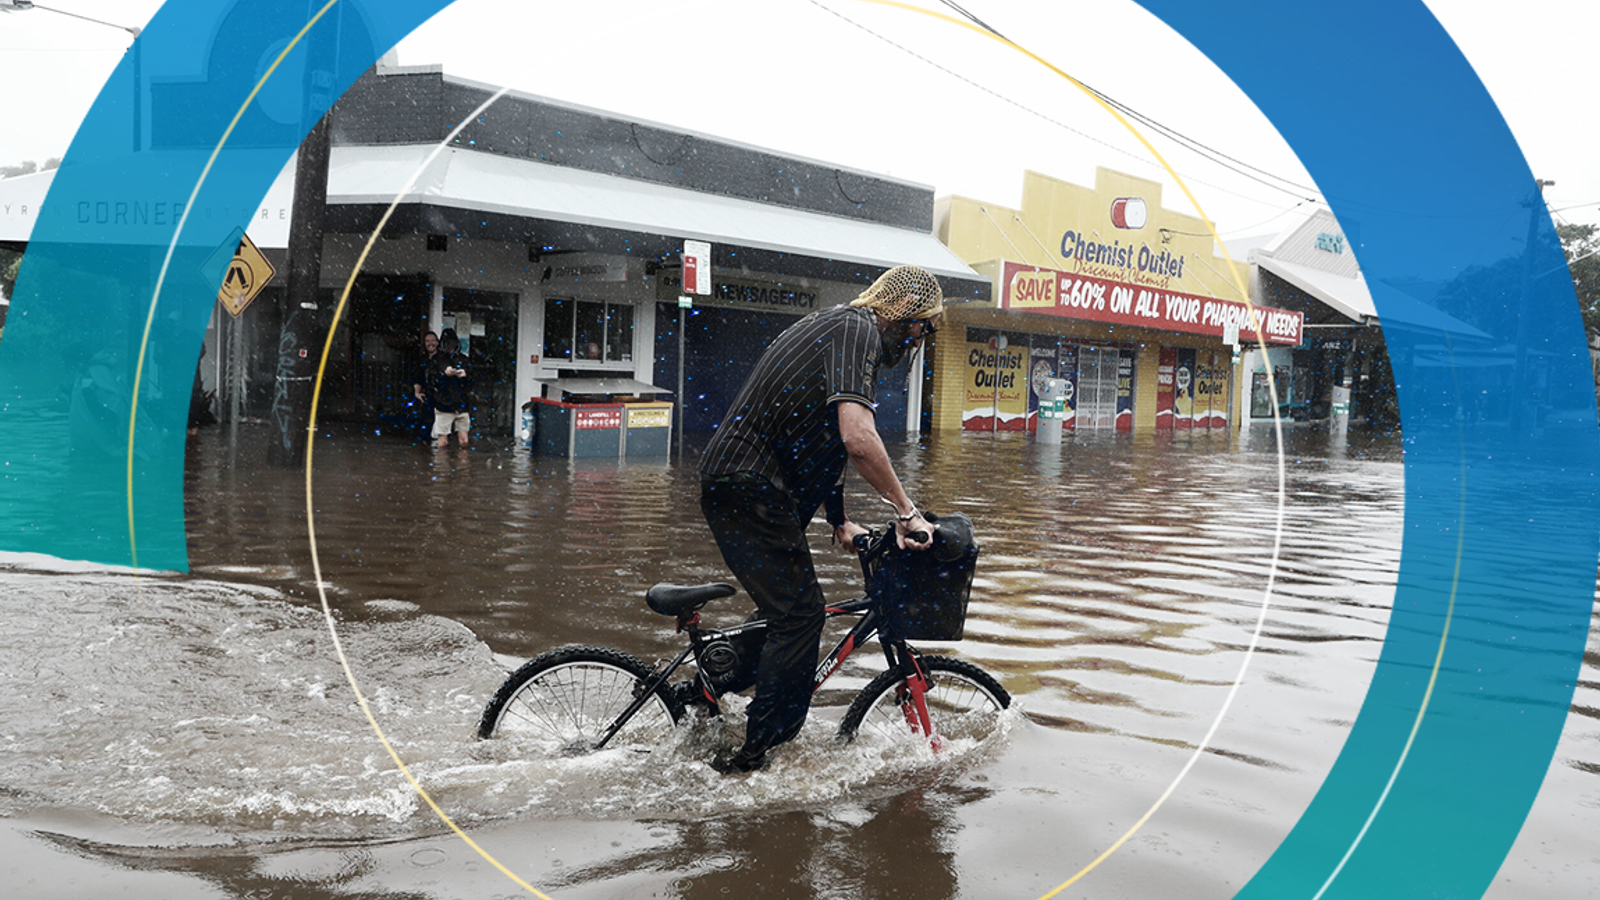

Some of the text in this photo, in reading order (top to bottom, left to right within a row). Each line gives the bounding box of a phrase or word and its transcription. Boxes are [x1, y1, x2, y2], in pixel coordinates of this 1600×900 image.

[77, 200, 186, 226] CORNER
[204, 206, 287, 221] STORE
[1061, 231, 1184, 279] Chemist Outlet
[1060, 278, 1072, 291] UP
[1073, 257, 1170, 289] Discount Chemist
[715, 283, 816, 309] NEWSAGENCY
[1016, 278, 1053, 301] SAVE
[1060, 293, 1070, 306] TO
[1071, 279, 1106, 311] 60%
[1110, 286, 1133, 315] ON
[1134, 289, 1159, 318] ALL
[1165, 294, 1200, 324] YOUR
[1202, 301, 1266, 332] PHARMACY
[1266, 312, 1300, 337] NEEDS
[969, 348, 1023, 370] Chemist
